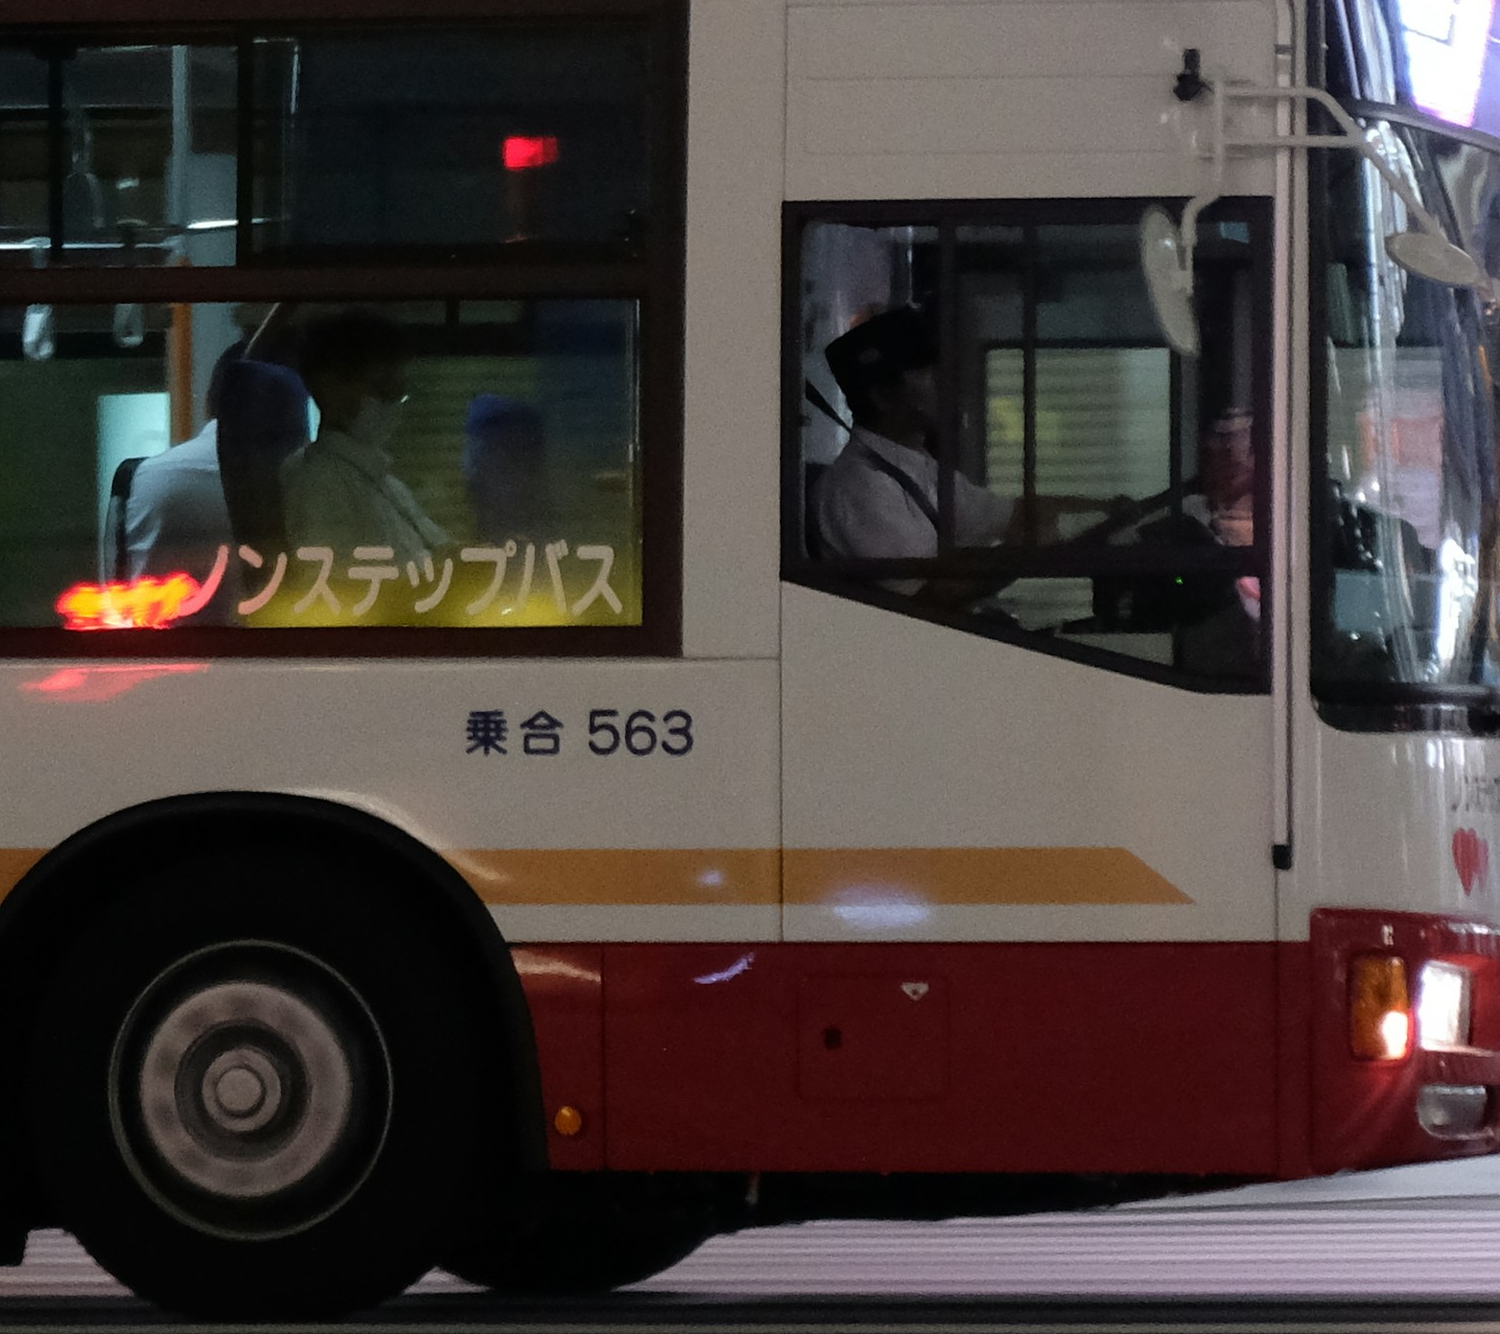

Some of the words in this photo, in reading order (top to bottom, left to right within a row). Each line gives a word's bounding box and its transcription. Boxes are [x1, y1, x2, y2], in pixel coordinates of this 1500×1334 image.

[175, 540, 623, 617] ノンステップバス
[588, 709, 694, 756] 563
